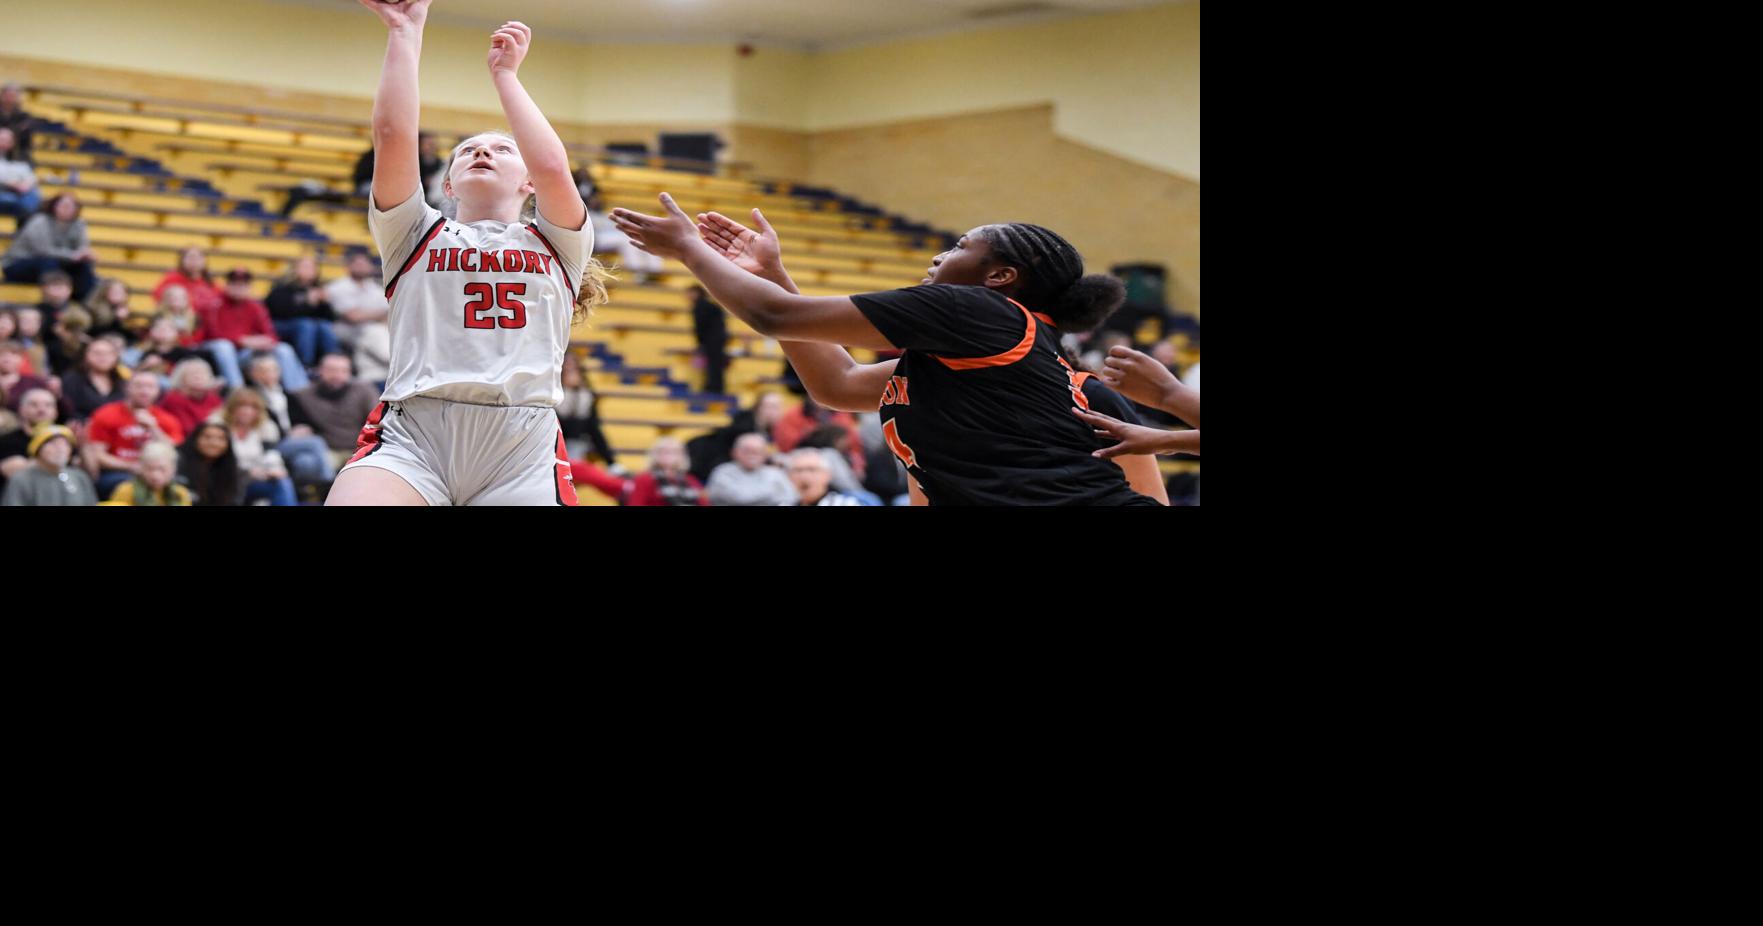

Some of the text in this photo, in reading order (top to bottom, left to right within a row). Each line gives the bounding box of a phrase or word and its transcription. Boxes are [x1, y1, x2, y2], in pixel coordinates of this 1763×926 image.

[426, 248, 553, 275] HICKORY
[464, 282, 527, 329] 25
[879, 375, 910, 409] ON
